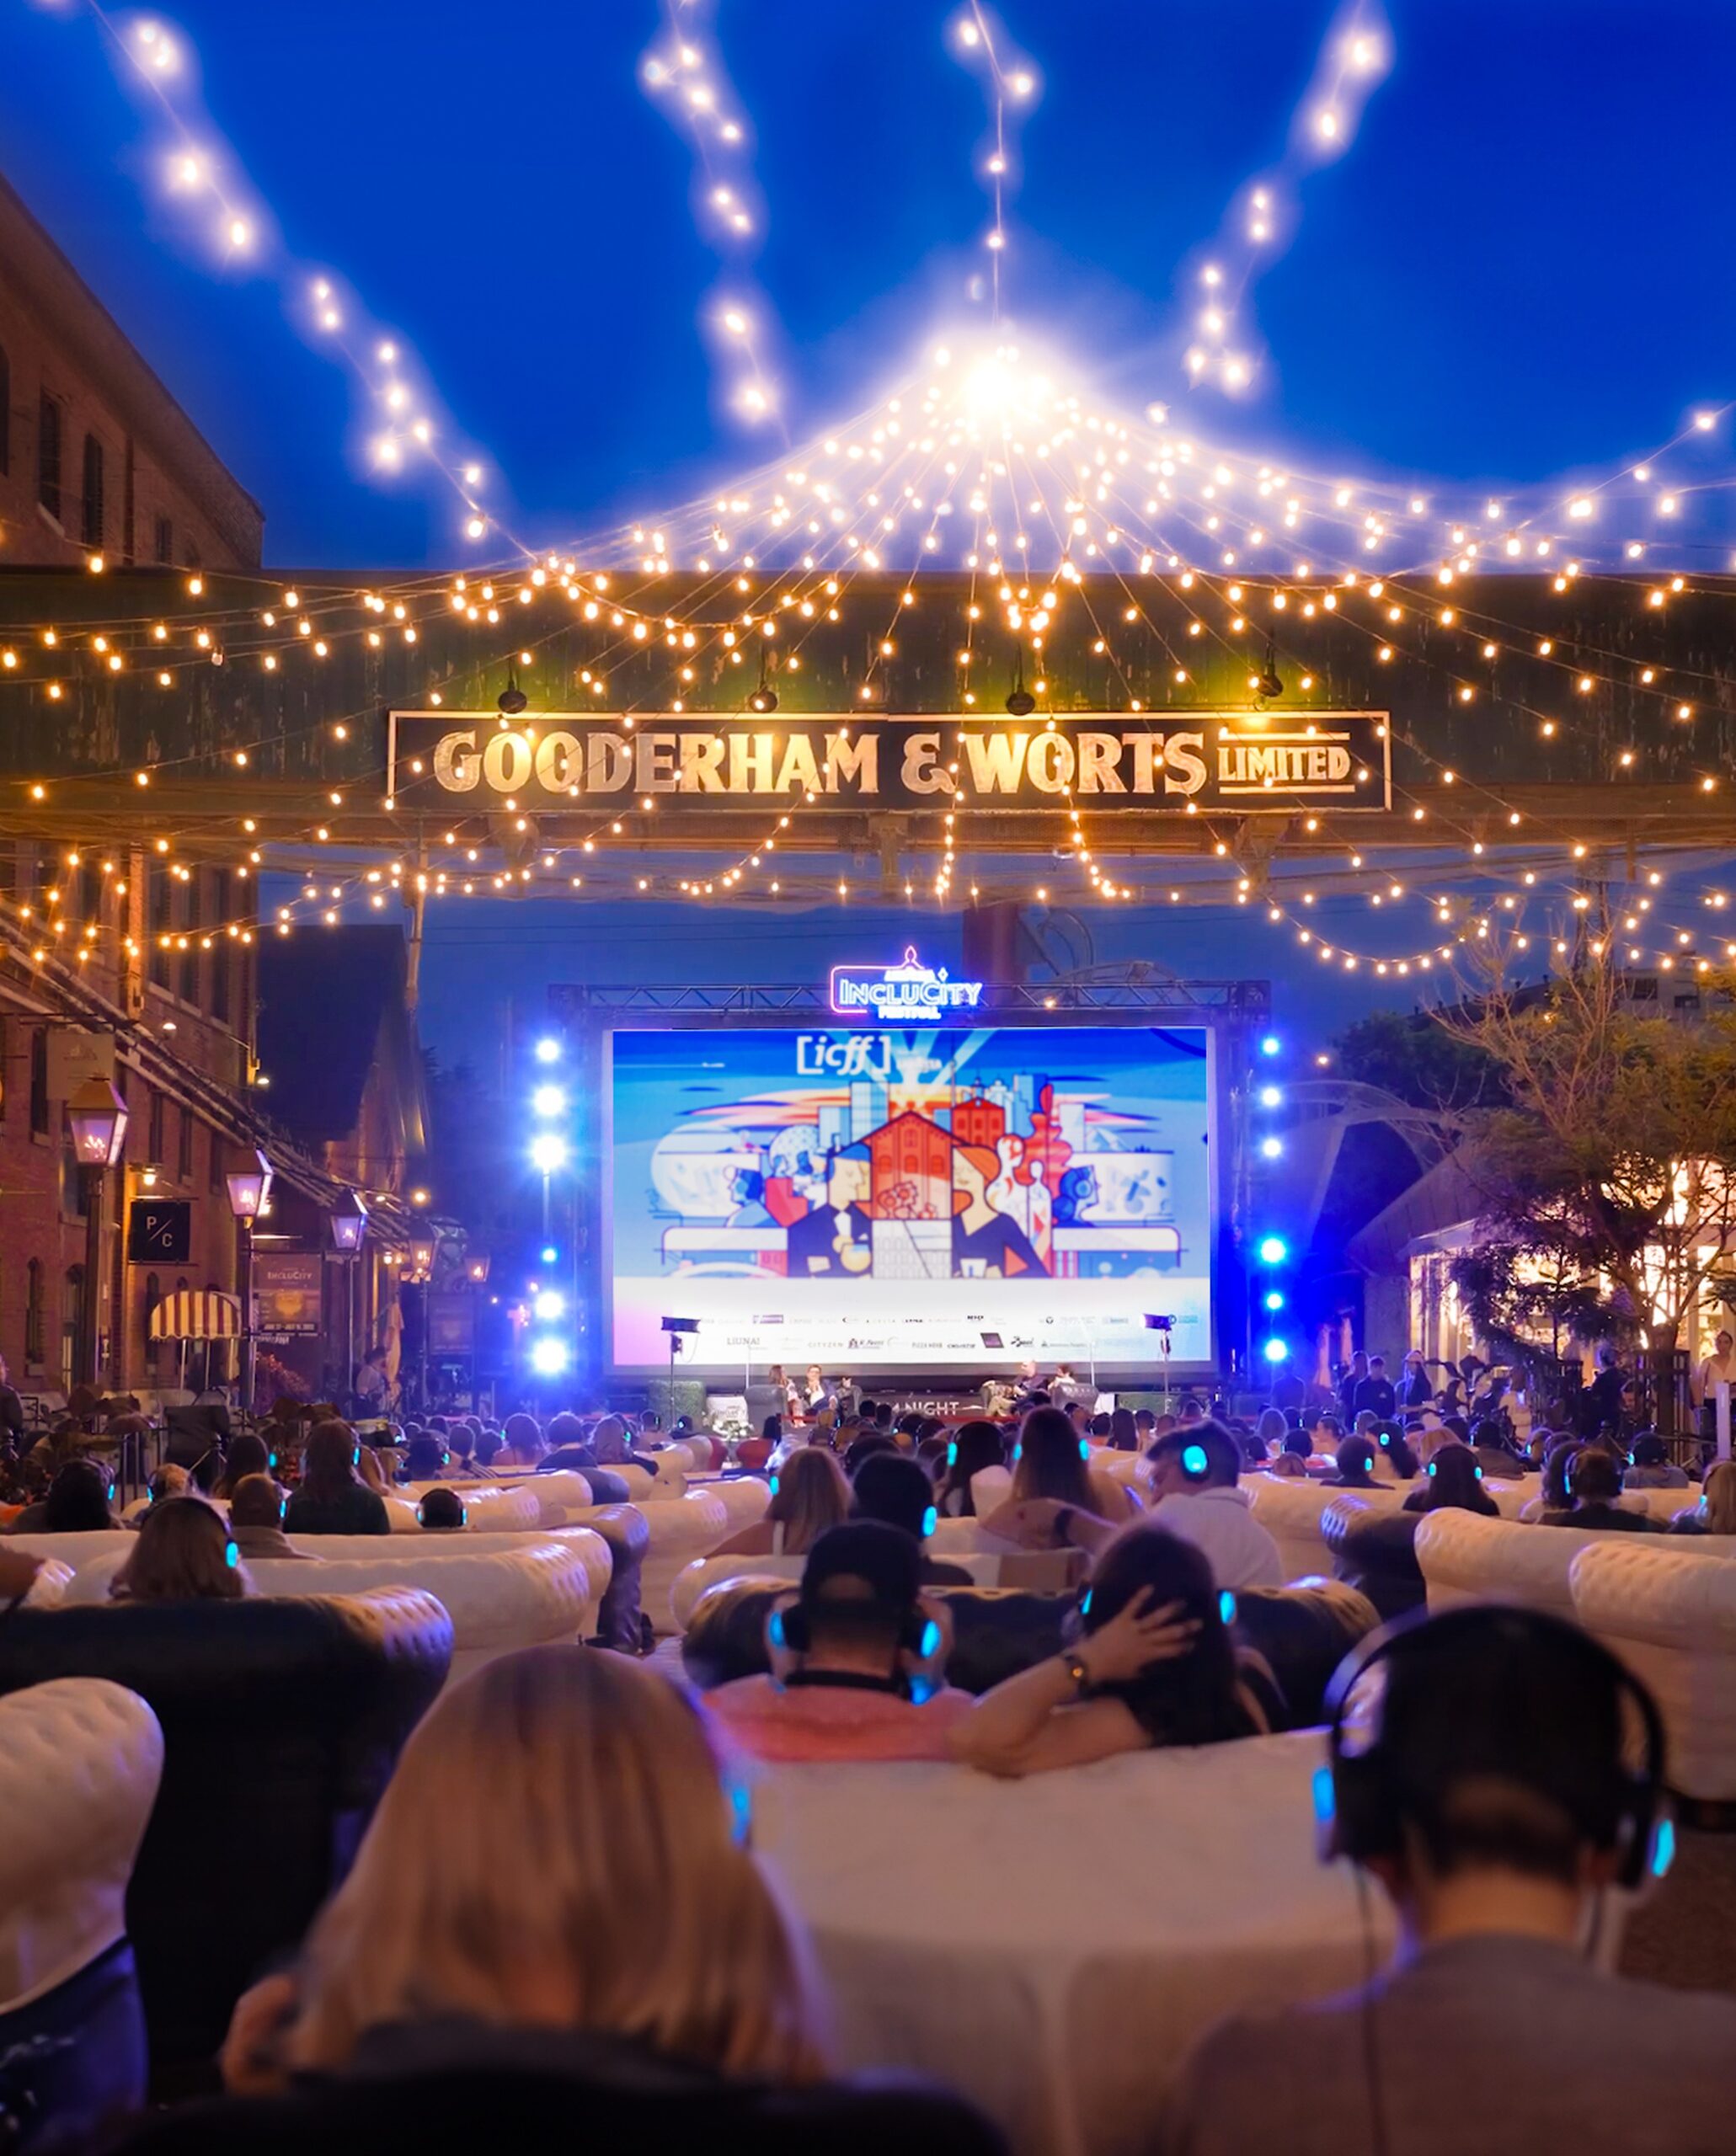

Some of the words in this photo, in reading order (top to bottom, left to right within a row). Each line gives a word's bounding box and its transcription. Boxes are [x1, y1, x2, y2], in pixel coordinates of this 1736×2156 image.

[434, 731, 879, 793] GOODERHAM
[900, 732, 957, 793] &
[965, 732, 1208, 795] WORTS
[1218, 746, 1350, 782] LIMITED
